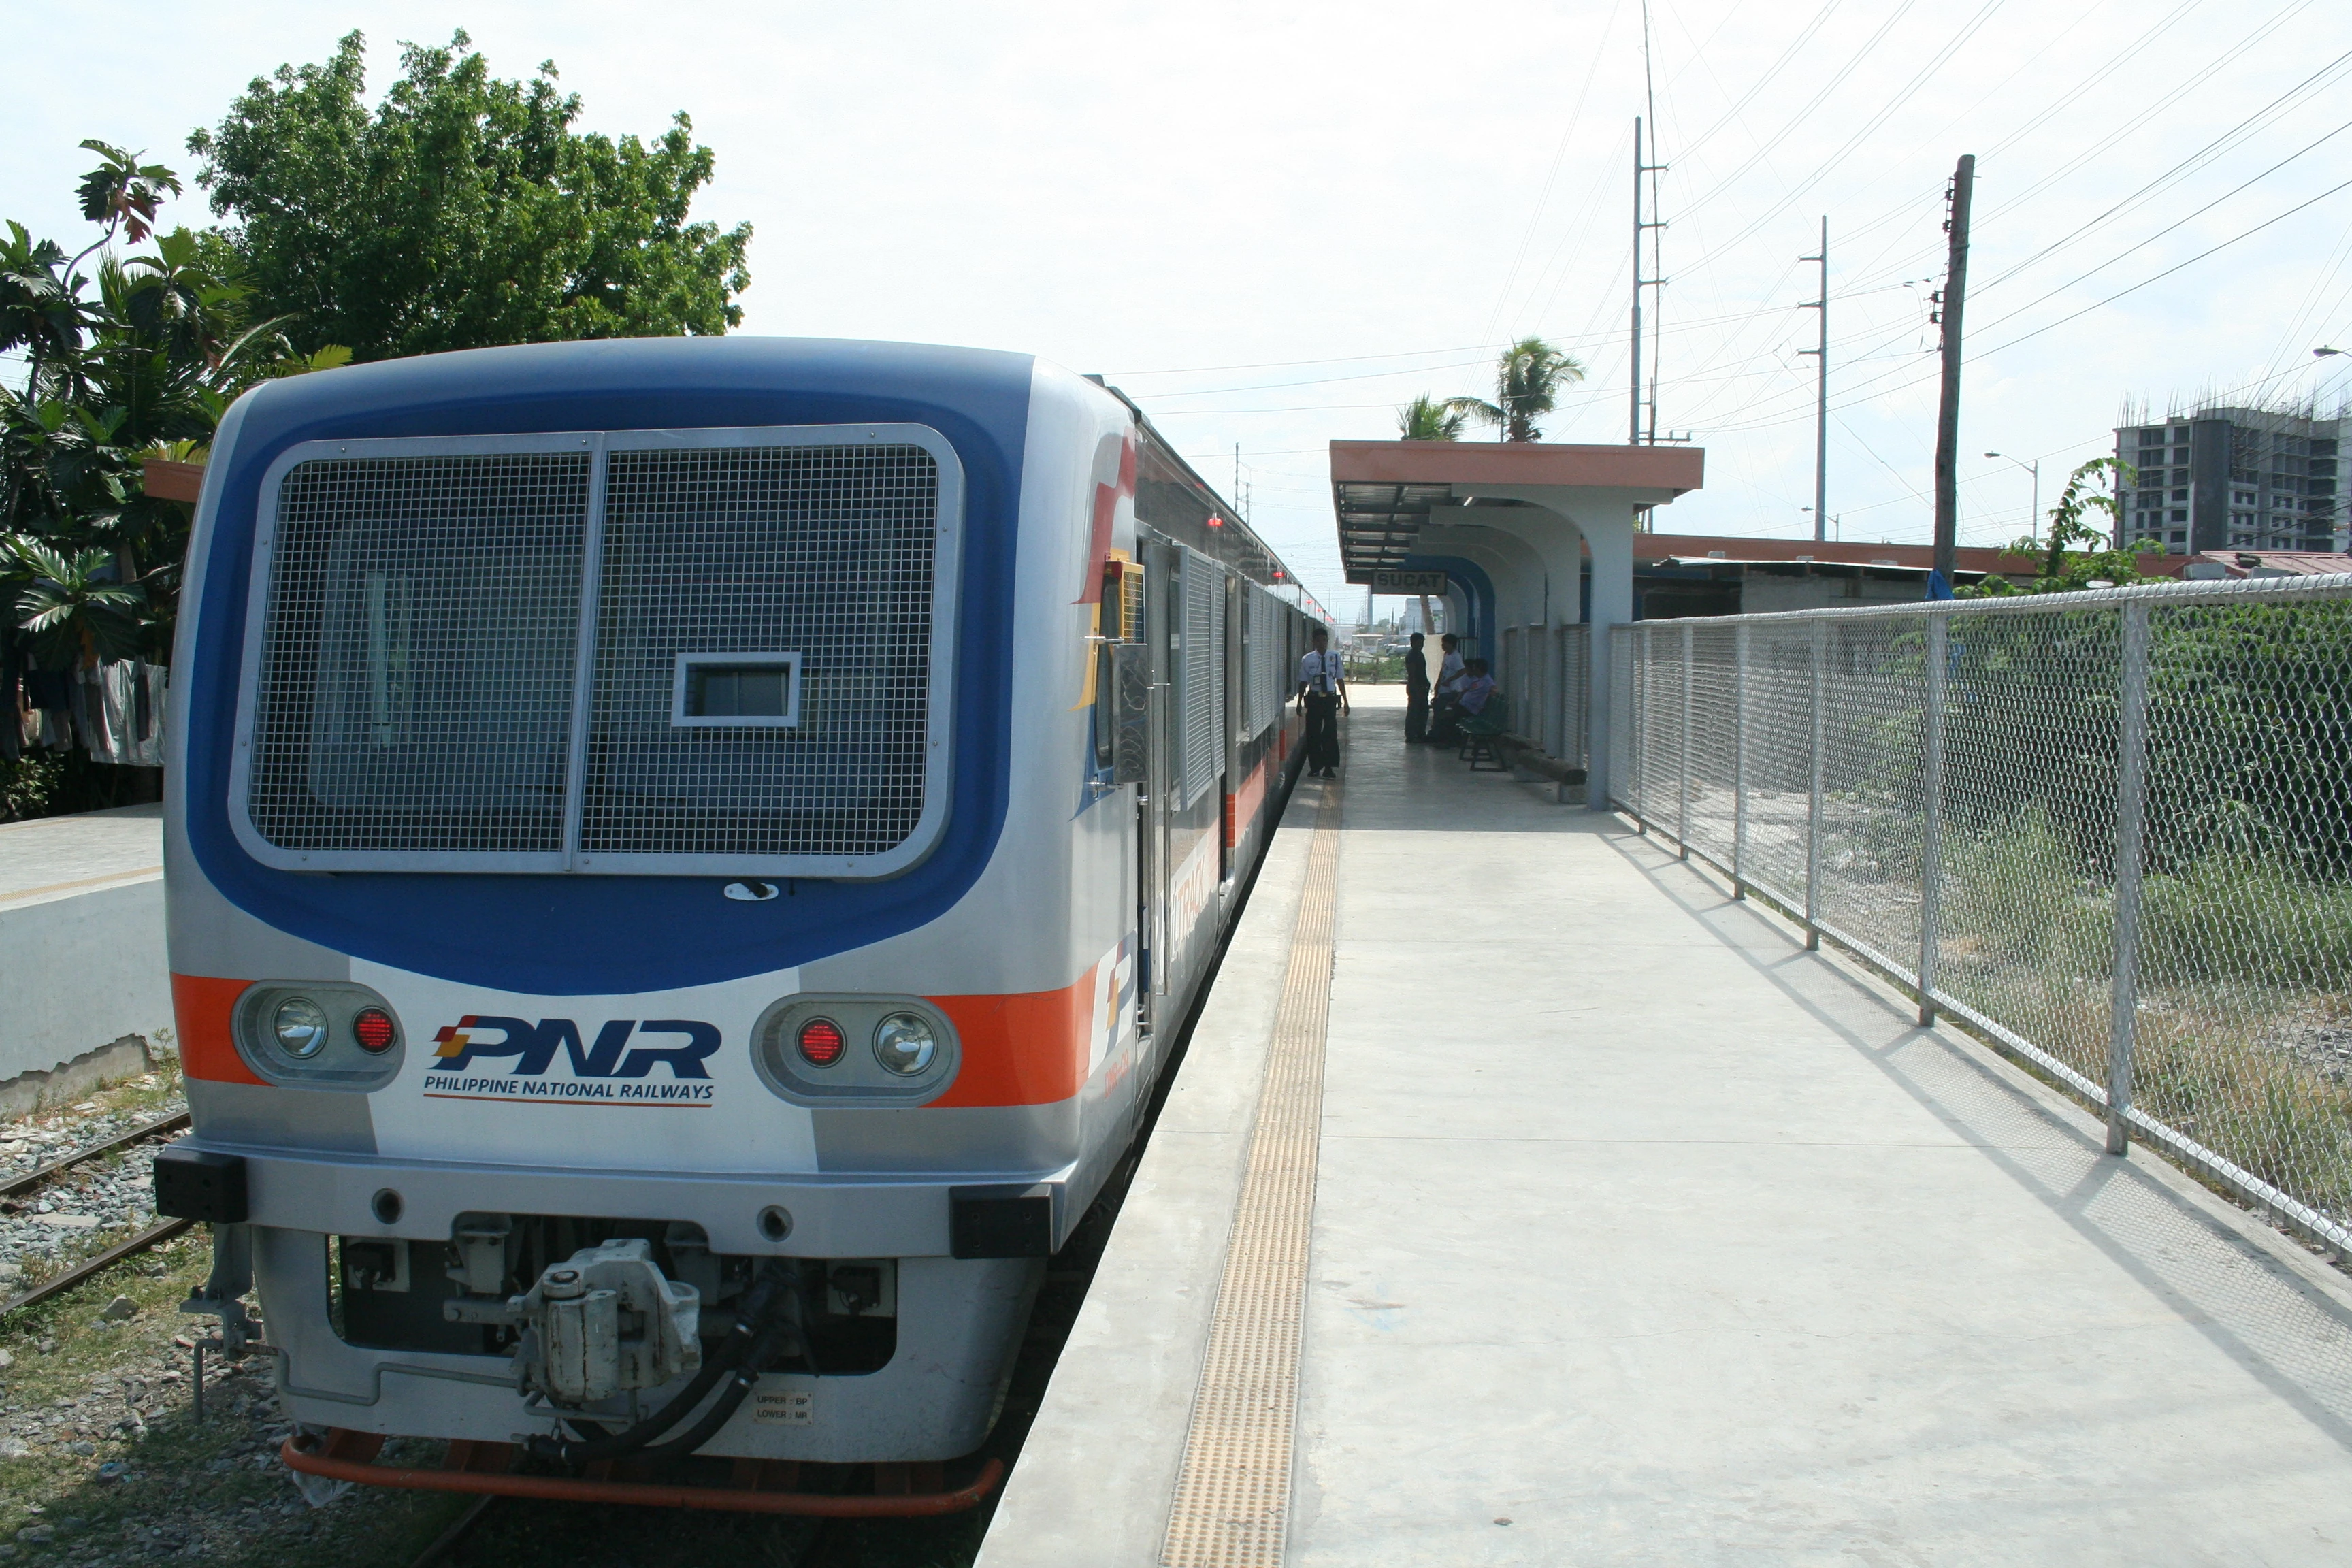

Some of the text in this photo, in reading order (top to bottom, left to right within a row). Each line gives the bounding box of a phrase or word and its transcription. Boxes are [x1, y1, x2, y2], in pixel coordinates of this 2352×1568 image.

[1377, 573, 1441, 588] SUCAT
[425, 1015, 722, 1079] PNR
[424, 1076, 715, 1100] PHILIPPINE NATIONAL RAILWAYS
[757, 1396, 786, 1404] UPPER
[796, 1397, 808, 1405] BP
[757, 1409, 787, 1418] LOWER
